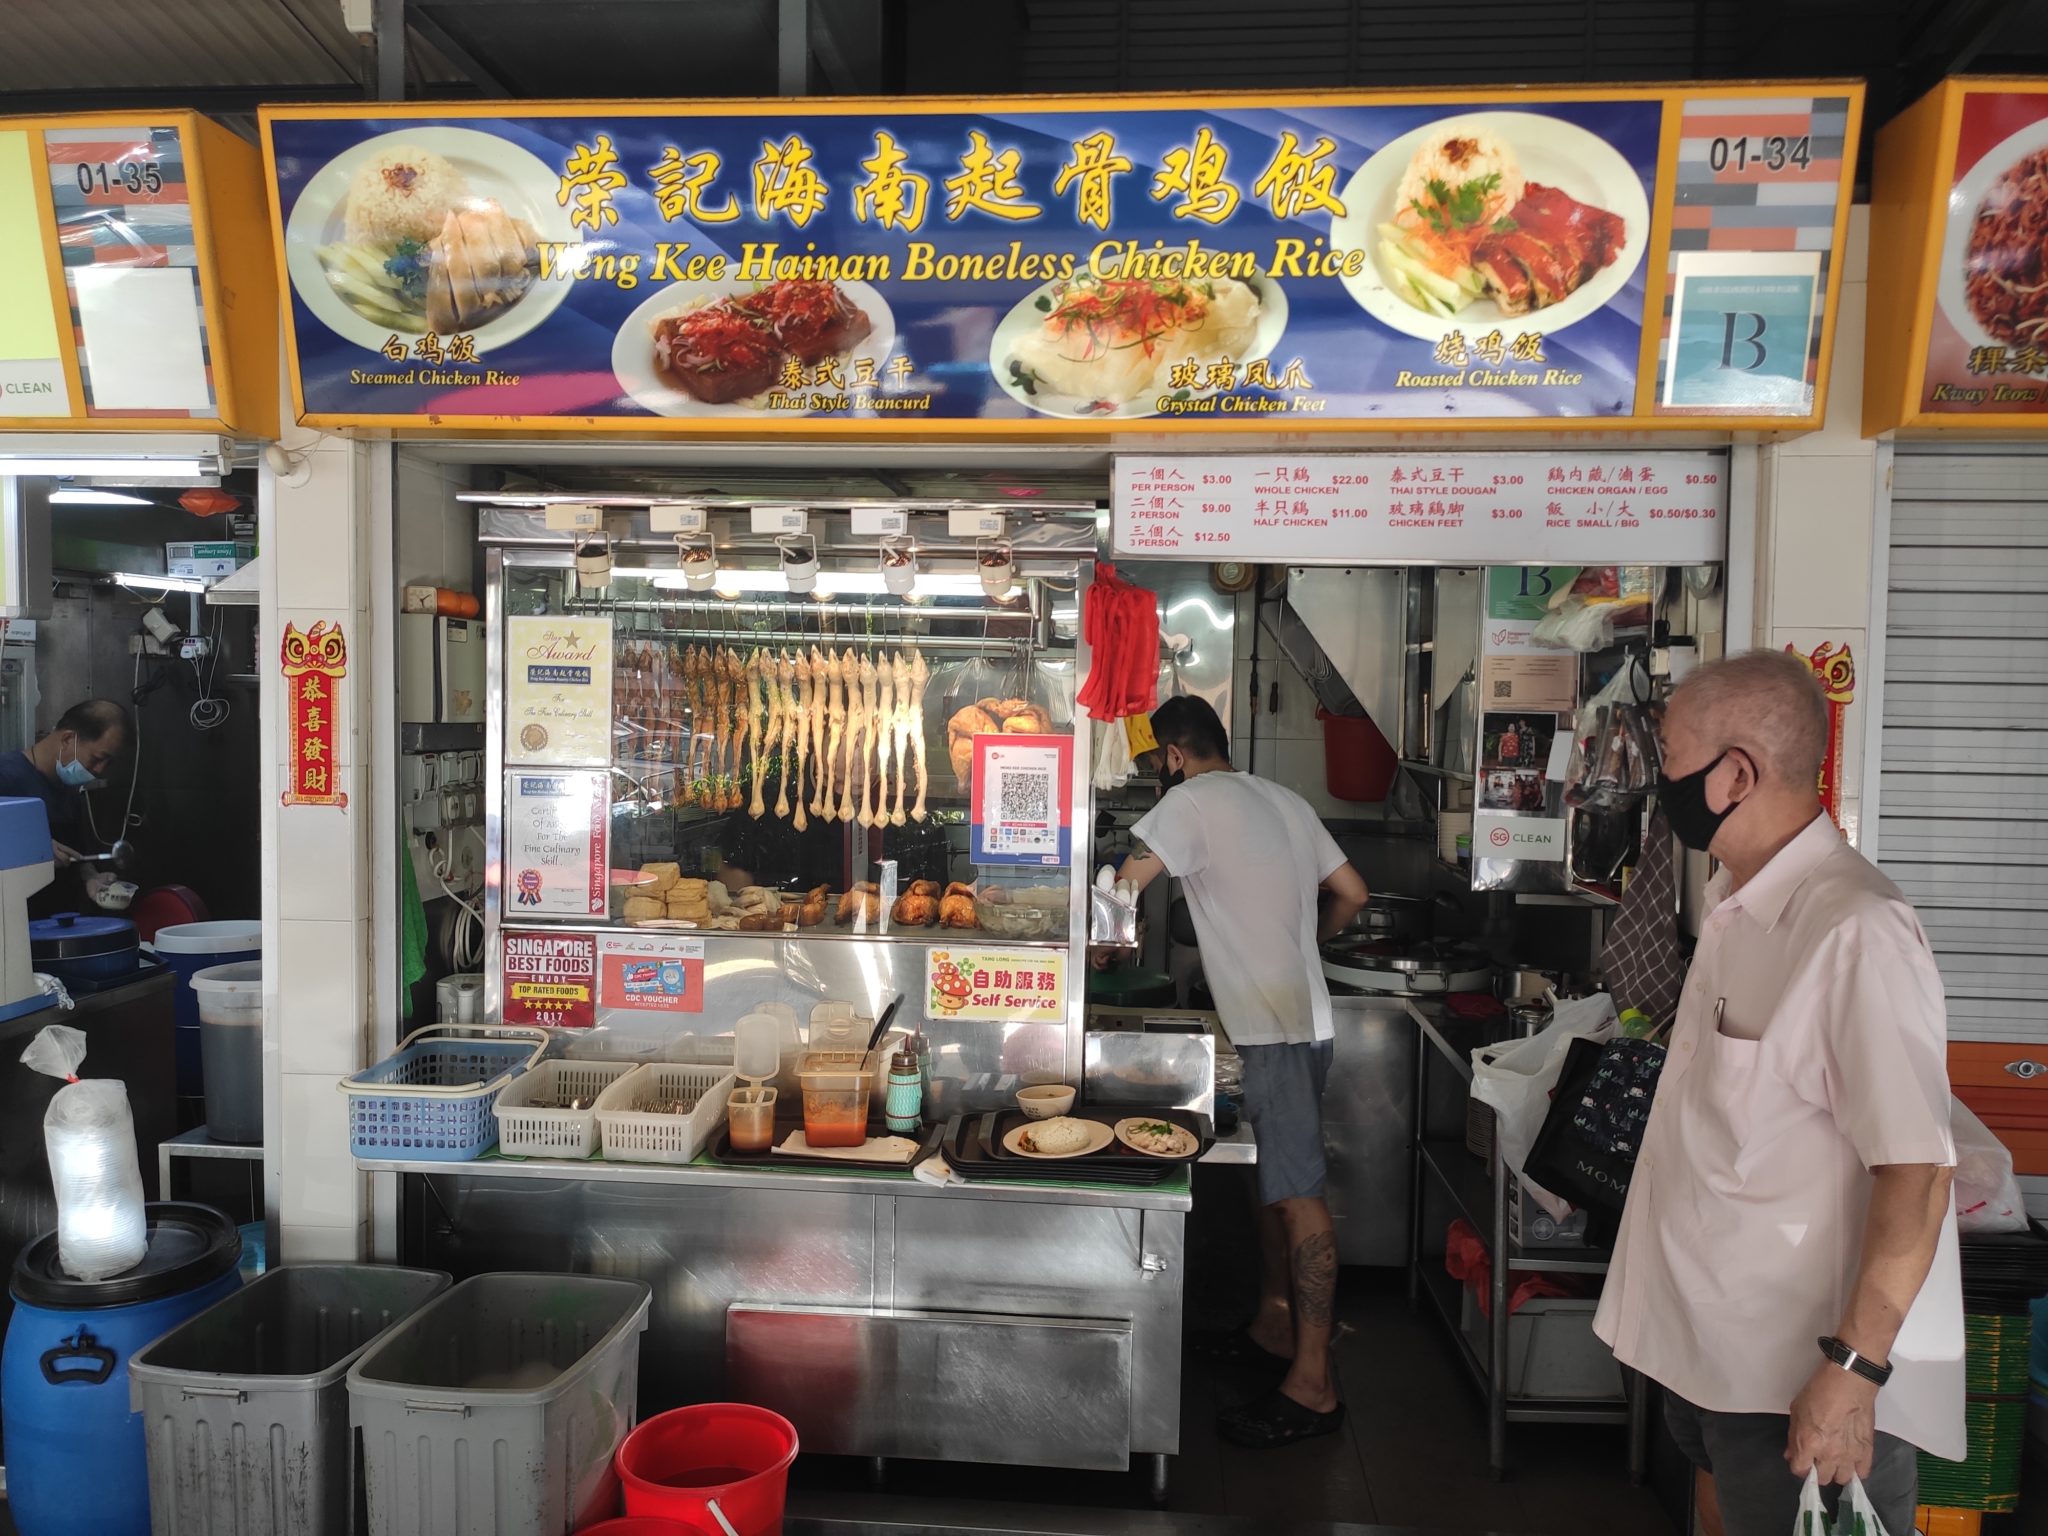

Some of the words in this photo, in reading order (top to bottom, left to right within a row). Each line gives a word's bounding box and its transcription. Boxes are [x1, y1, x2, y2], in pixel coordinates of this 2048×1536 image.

[1709, 135, 1811, 172] 01-34
[77, 162, 162, 194] 01-35
[649, 242, 727, 282] Kee
[735, 241, 891, 282] Hainan
[901, 240, 1076, 281] Boneless
[1088, 239, 1257, 280] Chicken
[1265, 237, 1365, 279] Rice
[1716, 311, 1767, 371] B
[381, 331, 481, 366] 白鸡饭
[1433, 329, 1547, 367] 烧鸡饭
[350, 369, 415, 385] Steamed
[418, 370, 481, 386] Chicken
[485, 370, 521, 386] Rice
[778, 354, 914, 391] 泰式豆干
[1168, 355, 1313, 392] 玻璃凤爪
[1395, 370, 1465, 388] Roasted
[1468, 370, 1538, 387] Chicken
[1542, 369, 1583, 386] Rice
[5, 382, 52, 394] CLEAN
[1932, 383, 1988, 406] Kway
[1992, 383, 2039, 403] Teow
[769, 392, 807, 410] Thai
[809, 392, 850, 414] Style
[854, 393, 931, 411] Beancurd
[1156, 395, 1217, 415] Crystal
[1220, 395, 1287, 413] Chicken
[1291, 396, 1327, 413] Feet
[1131, 467, 1185, 480] 一個人
[1202, 475, 1232, 484] $3.00
[1332, 475, 1369, 485] $22.00
[1390, 466, 1465, 483] 泰式豆干
[1492, 475, 1524, 485] $3.00
[1685, 474, 1717, 484] $0.50
[1131, 483, 1151, 491] PER
[1154, 483, 1195, 492] PERSON
[1254, 486, 1291, 494] WHOLE
[1294, 486, 1339, 495] CHICKEN
[1390, 487, 1413, 495] THAI
[1416, 487, 1448, 495] STYLE
[1451, 487, 1497, 495] DOUGAN
[1547, 486, 1594, 494] CHICKEN
[1597, 486, 1636, 495] ORGAN
[1645, 486, 1668, 495] EGG
[1130, 495, 1185, 509] 二個人
[1202, 503, 1231, 513] $9.00
[1545, 501, 1564, 516] 飯
[1130, 511, 1136, 519] 2
[1139, 511, 1180, 519] PERSON
[1331, 508, 1368, 518] $11.00
[1491, 509, 1523, 519] $3.00
[1649, 508, 1716, 519] $0.50/$0.30
[1253, 518, 1280, 526] HALF
[1283, 519, 1328, 527] CHICKEN
[1388, 519, 1435, 527] CHICKEN
[1437, 519, 1464, 527] FEET
[1546, 519, 1571, 527] RICE
[1576, 519, 1612, 527] SMALL
[1621, 519, 1640, 527] BIG
[1129, 524, 1184, 538] 三個人
[1194, 532, 1230, 542] $12.50
[1129, 539, 1135, 547] 3
[1138, 539, 1179, 547] PERSON
[526, 639, 596, 661] Award
[300, 675, 329, 793] 恭喜發財
[1493, 832, 1507, 841] SG
[1512, 833, 1552, 843] CLEAN
[524, 844, 541, 853] Fine
[543, 843, 580, 856] Culinary
[592, 843, 605, 898] Singapore
[506, 938, 593, 957] SINGAPORE
[508, 957, 542, 971] BEST
[545, 958, 590, 973] FOODS
[531, 975, 567, 983] ENJOY
[973, 969, 1056, 991] 自助服務
[518, 985, 532, 993] TOP
[533, 986, 554, 994] RATED
[556, 987, 579, 995] FOODS
[625, 994, 641, 1002] CDC
[642, 995, 679, 1004] VOUCHER
[971, 993, 1000, 1007] Self
[1004, 995, 1056, 1009] Service
[536, 1011, 563, 1021] 2017
